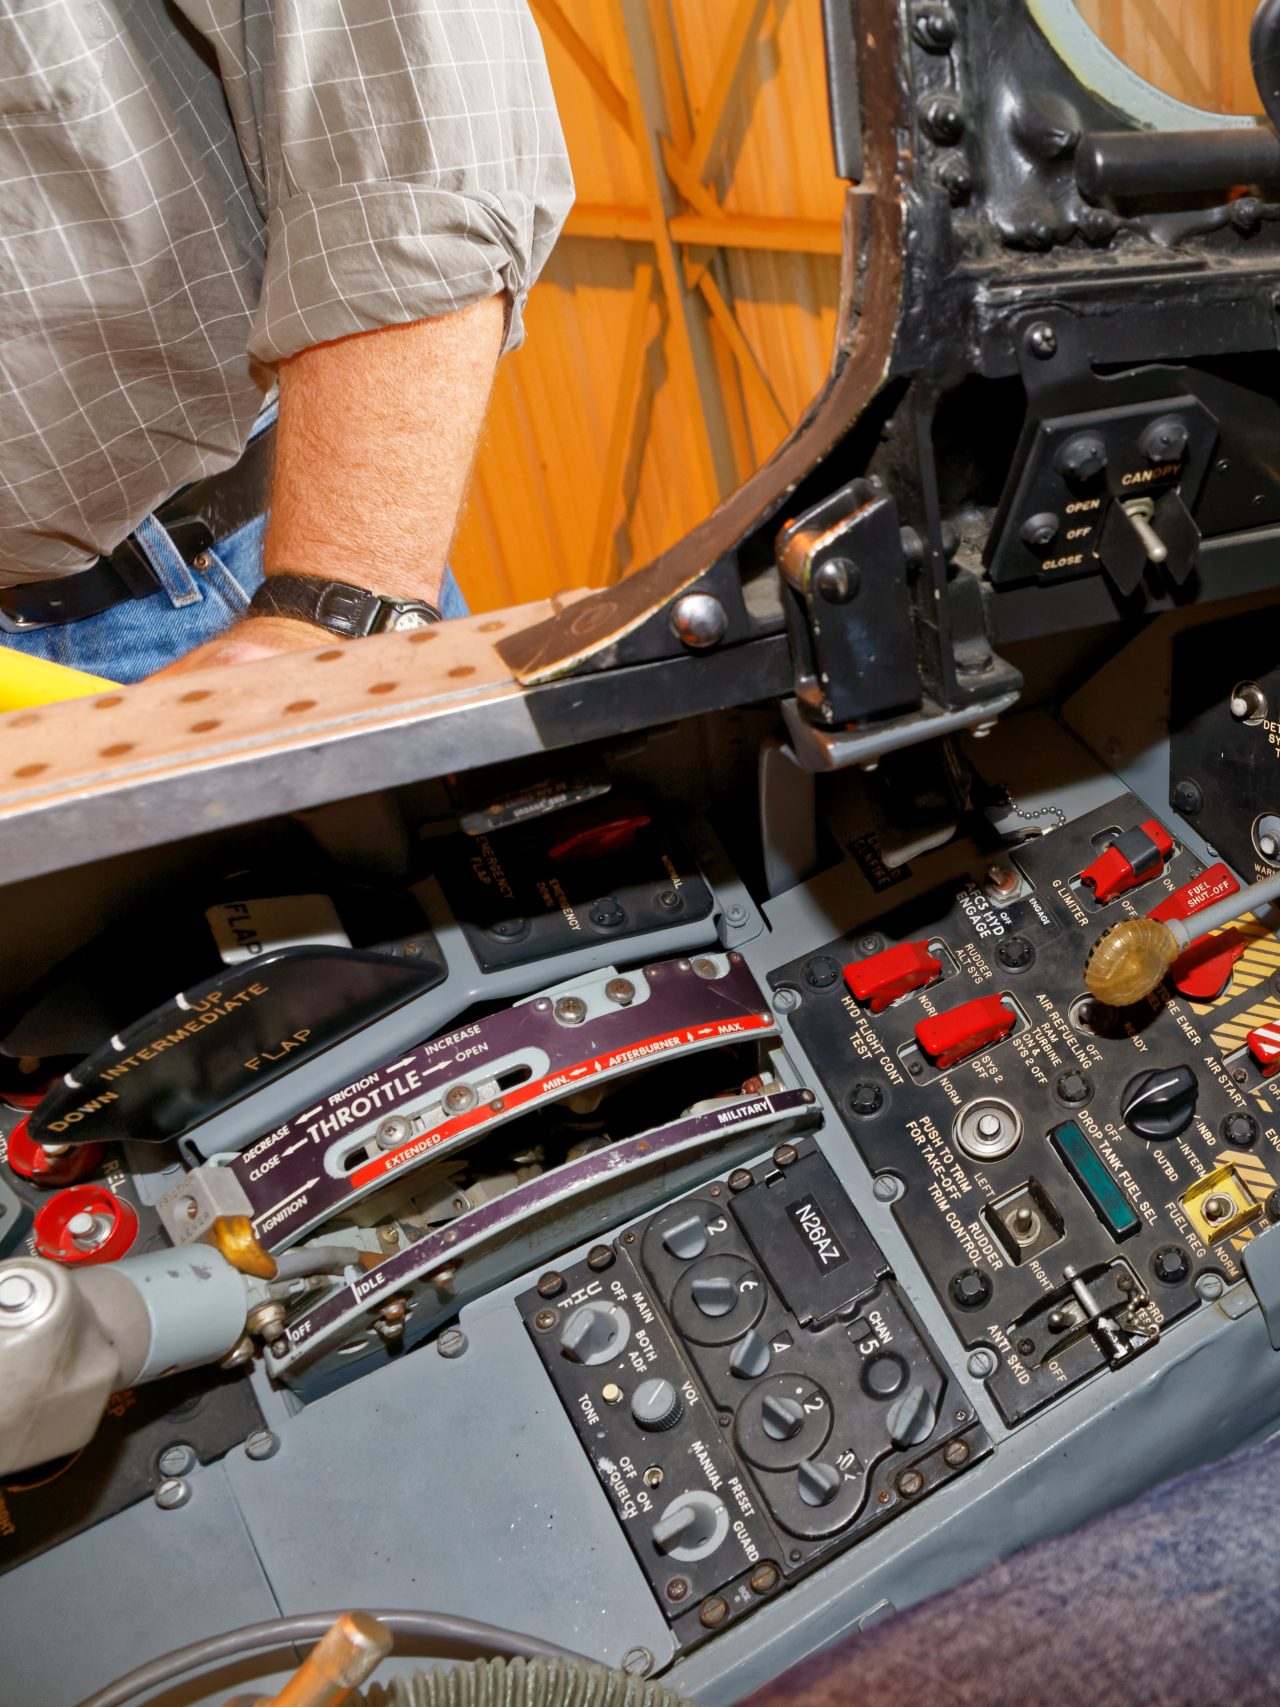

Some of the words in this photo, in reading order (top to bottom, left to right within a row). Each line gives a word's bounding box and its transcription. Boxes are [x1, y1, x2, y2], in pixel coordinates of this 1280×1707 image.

[1121, 464, 1182, 486] CANOPY
[1065, 498, 1101, 514] OPEN
[1066, 526, 1092, 540] OFF
[1042, 553, 1084, 571] CLOSE
[1163, 878, 1176, 891] ON
[1187, 880, 1230, 908] SHUT-OFF
[1188, 882, 1211, 897] FUEL
[956, 891, 991, 939] ENGAGE
[965, 882, 988, 911] AFCS
[983, 910, 1005, 936] HYD
[1000, 911, 1012, 926] OFF
[1029, 898, 1050, 926] ENGAGE
[1052, 879, 1062, 888] G
[1058, 887, 1089, 927] LIMITER
[1122, 900, 1138, 918] OFF
[225, 903, 263, 956] FLAP
[955, 949, 972, 965] ALT
[967, 965, 983, 985] SYS
[964, 943, 993, 979] RUDDER
[100, 983, 270, 1081] INTERMEDIATE
[841, 996, 861, 1018] HYD
[856, 1016, 885, 1055] FLIGHT
[879, 1056, 904, 1086] CONT
[849, 1031, 873, 1060] TEST
[1022, 1033, 1034, 1046] ON
[1036, 993, 1053, 1012] AIR
[1049, 1012, 1092, 1069] REFUELING
[1041, 1023, 1057, 1043] RAM
[1124, 1022, 1148, 1053] READY
[1176, 1015, 1202, 1046] EMER
[244, 1028, 313, 1072] FLAP
[1013, 1038, 1029, 1059] SYS
[1031, 1066, 1048, 1085] OFF
[1032, 1027, 1062, 1067] TURBINE
[1086, 1044, 1103, 1062] OFF
[971, 1061, 988, 1079] OFF
[982, 1055, 998, 1076] SYS
[242, 1125, 291, 1164] DECREASE
[328, 1072, 380, 1106] FRICTION
[424, 1024, 481, 1056] INCREASE
[385, 1133, 441, 1170] EXTENDED
[543, 1075, 571, 1092] MIN.
[608, 1036, 681, 1067] AFTERBURNER
[717, 1022, 744, 1035] MAX.
[939, 1077, 962, 1106] NORM
[1204, 1056, 1221, 1075] AIR
[1218, 1074, 1247, 1108] START
[47, 1090, 119, 1133] DOWN
[249, 1154, 281, 1182] CLOSE
[306, 1069, 423, 1144] THROTTLE
[455, 1042, 489, 1063] OPEN
[1104, 1123, 1122, 1143] OFF
[1197, 1122, 1216, 1146] INBD
[906, 1121, 926, 1146] FOR
[922, 1146, 962, 1200] TAKE-OFF
[919, 1115, 944, 1149] PUSH
[943, 1148, 954, 1164] TO
[950, 1164, 973, 1193] TRIM
[1078, 1110, 1103, 1142] DROP
[1099, 1141, 1124, 1172] TANK
[1119, 1171, 1143, 1202] FUEL
[1139, 1201, 1158, 1226] SEL
[1153, 1150, 1179, 1182] OUTBD
[974, 1172, 996, 1198] LEFT
[262, 1195, 308, 1233] IGNITION
[292, 1321, 312, 1342] OFF
[357, 1272, 386, 1298] IDLE
[717, 1101, 768, 1125] MILITARY
[707, 1219, 728, 1236] 2
[928, 1181, 951, 1212] TRIM
[945, 1213, 983, 1268] CONTROL
[1164, 1202, 1185, 1234] FUEL
[1186, 1233, 1206, 1258] REG
[795, 1203, 840, 1265] N26AZ
[968, 1221, 1003, 1272] RUDDER
[1029, 1260, 1054, 1291] RIGHT
[1214, 1246, 1240, 1277] NORM
[610, 1281, 628, 1302] OFF
[632, 1292, 655, 1324] MAIN
[1147, 1301, 1165, 1324] GRD
[868, 1311, 893, 1344] CHAN
[628, 1350, 648, 1373] ADF
[635, 1329, 658, 1362] BOTH
[987, 1324, 1012, 1353] ANTI
[1007, 1354, 1030, 1385] SKID
[1048, 1361, 1067, 1382] OFF
[578, 1393, 600, 1426] TONE
[681, 1381, 700, 1407] VOL
[804, 1397, 824, 1414] 2
[619, 1456, 637, 1479] OFF
[691, 1440, 723, 1491] MANUAL
[606, 1465, 638, 1519] SQUELCH
[636, 1491, 653, 1513] ON
[728, 1476, 756, 1518] PRESET
[733, 1520, 760, 1563] GUARD
